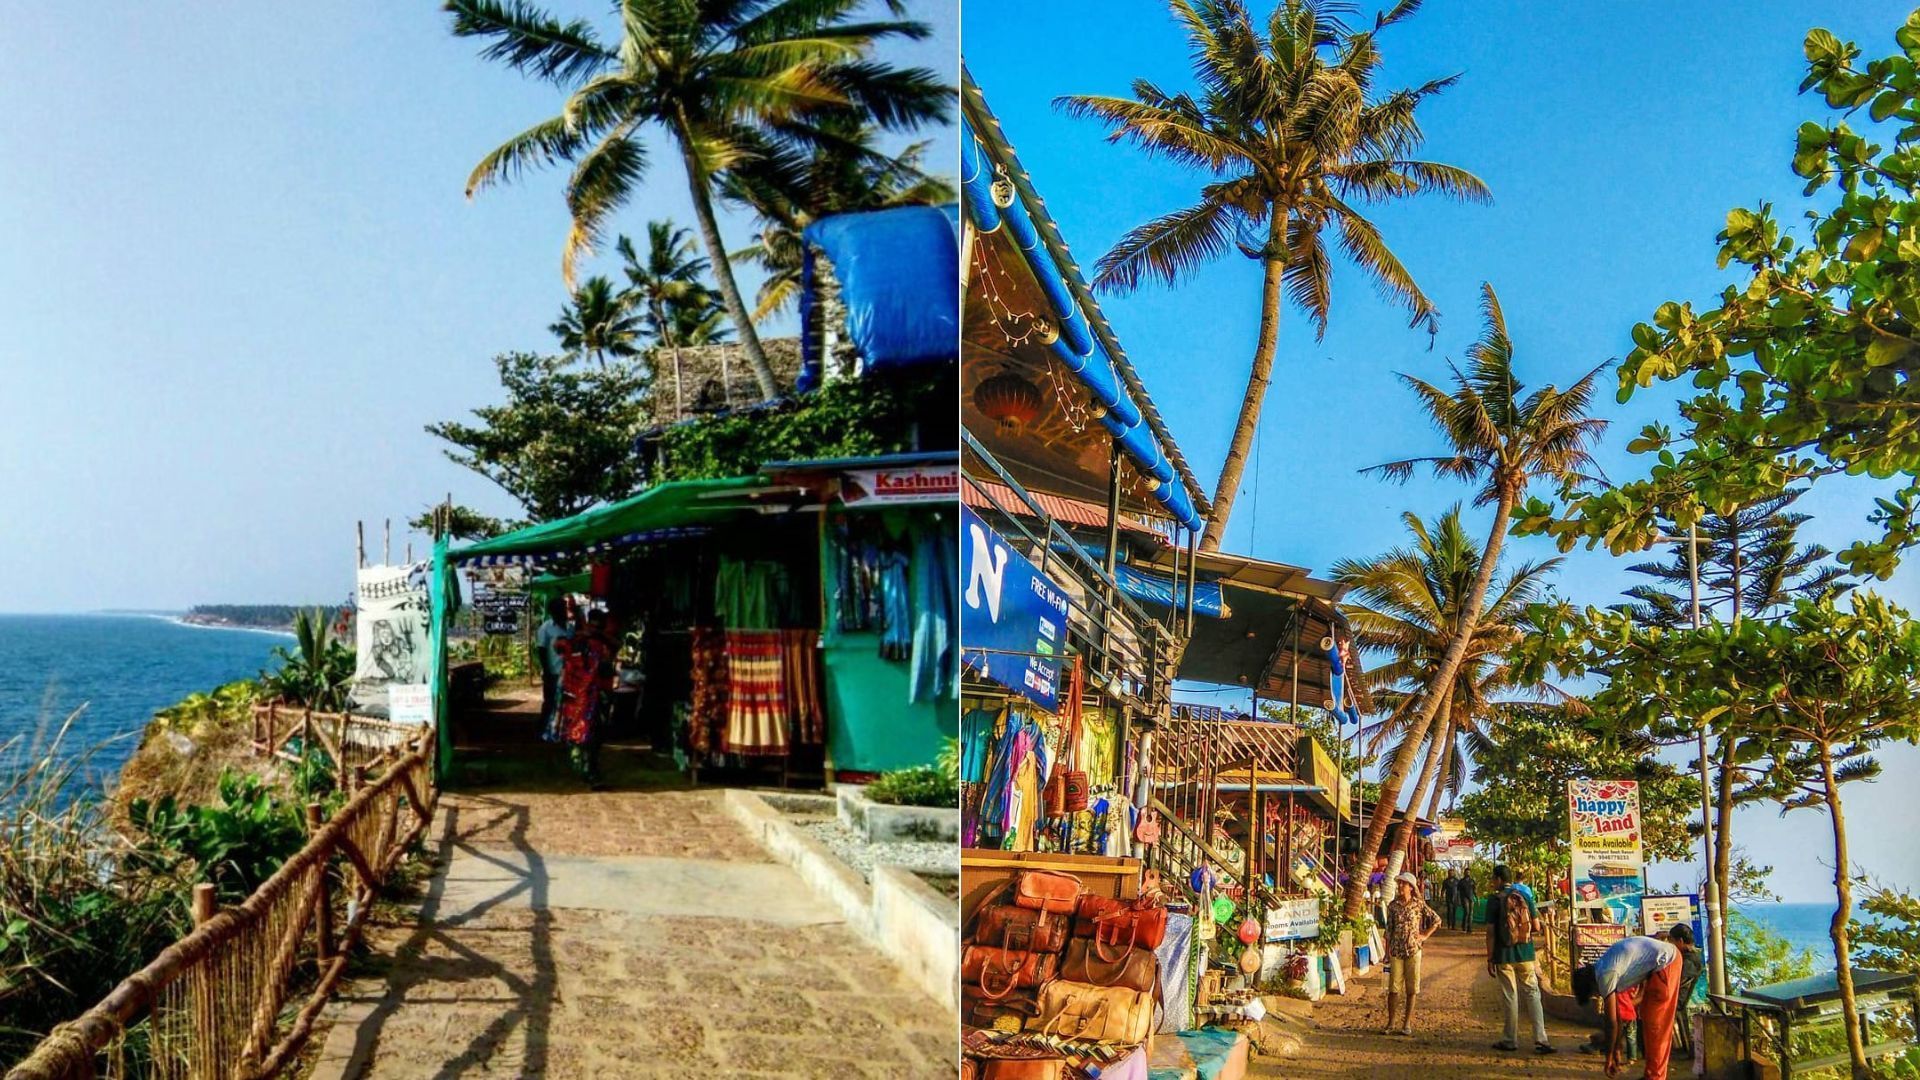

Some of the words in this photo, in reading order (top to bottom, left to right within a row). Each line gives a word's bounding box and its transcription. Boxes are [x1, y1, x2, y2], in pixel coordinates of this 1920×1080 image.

[965, 523, 1008, 624] N
[1031, 576, 1046, 600] FREE
[1029, 656, 1038, 670] We
[1038, 662, 1055, 681] Accept
[1577, 797, 1626, 815] happy
[1595, 814, 1634, 833] land
[1578, 838, 1601, 848] Rooms
[1602, 838, 1634, 848] Available
[1594, 927, 1616, 936] Light
[1617, 927, 1625, 935] of
